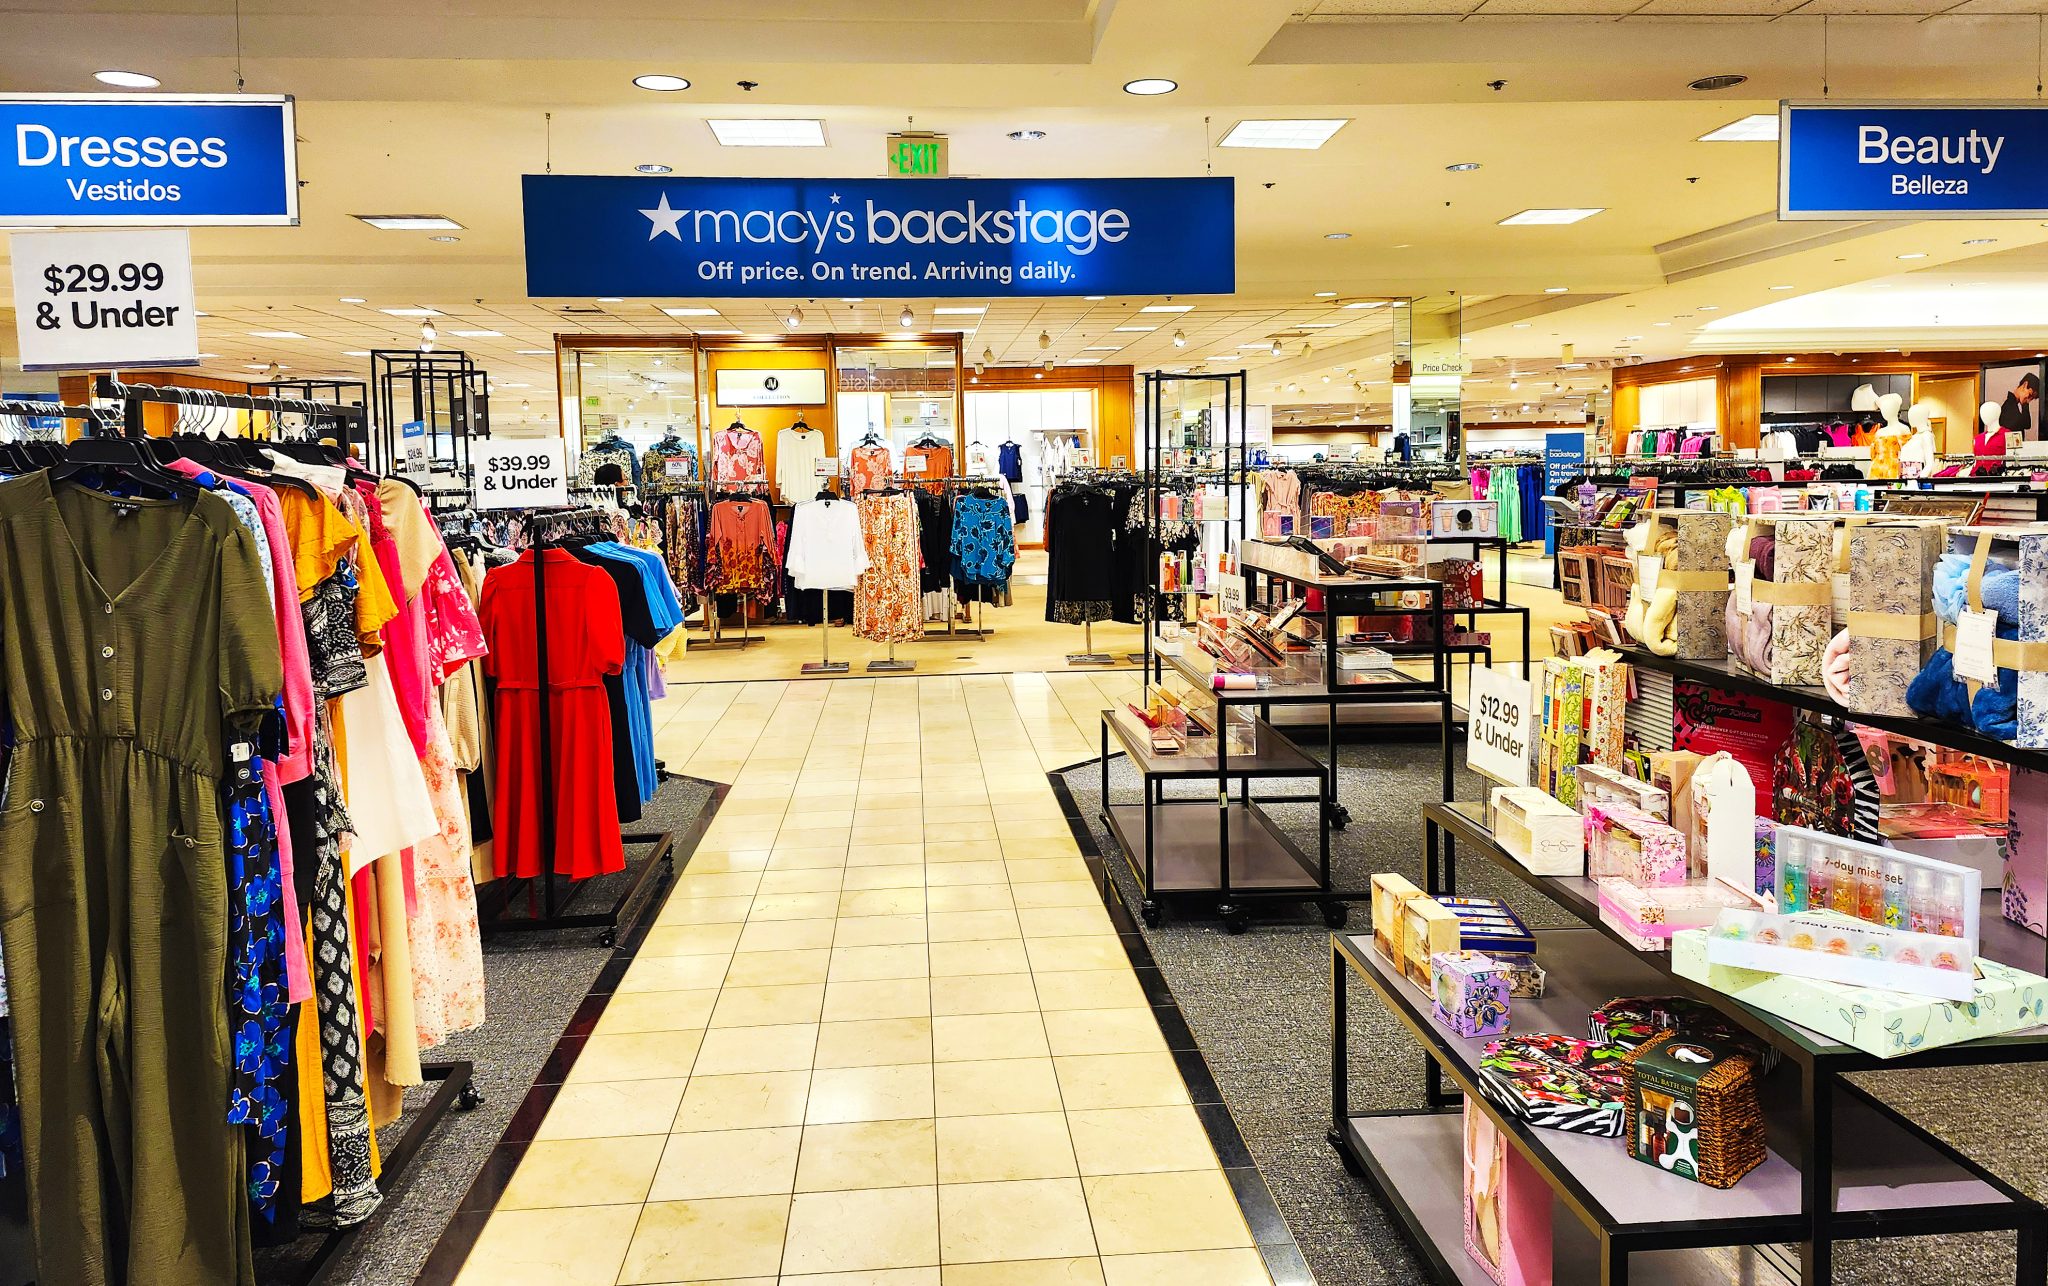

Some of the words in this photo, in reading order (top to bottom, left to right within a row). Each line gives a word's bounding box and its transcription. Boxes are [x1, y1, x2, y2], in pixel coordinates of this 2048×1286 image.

[16, 123, 228, 168] Dresses
[1858, 125, 2005, 174] Beauty
[899, 143, 939, 174] EXIT
[66, 178, 182, 202] Vestidos
[1891, 174, 1968, 195] Belleza
[694, 192, 855, 254] macy's
[866, 199, 1130, 256] backstage
[43, 262, 164, 297] $29.99
[697, 261, 734, 280] Off
[741, 261, 805, 284] price.
[811, 261, 845, 281] On
[850, 261, 917, 281] trend.
[923, 261, 1012, 285] Arriving
[1019, 260, 1076, 284] daily.
[35, 301, 61, 331] &
[71, 299, 180, 330] Under
[1422, 363, 1440, 372] Price
[1441, 363, 1463, 372] Check
[488, 454, 550, 473] $39.99
[1549, 451, 1582, 459] backstage
[1561, 462, 1575, 471] pric
[412, 461, 426, 473] Under
[483, 475, 497, 491] &
[501, 474, 558, 490] Under
[1225, 587, 1240, 601] $9.99
[1226, 601, 1243, 616] Under
[1480, 692, 1519, 727] $12.99
[1474, 718, 1482, 740] &
[1485, 722, 1524, 758] Under
[1740, 731, 1769, 739] COLLECTION
[1824, 856, 1854, 876] 7-day
[1856, 866, 1882, 879] mist
[1884, 873, 1904, 885] set
[1789, 919, 1828, 928] 7-day
[1832, 925, 1865, 933] mist
[1636, 1071, 1660, 1084] TOTAL
[1660, 1078, 1680, 1090] BATH
[1680, 1084, 1694, 1094] SET
